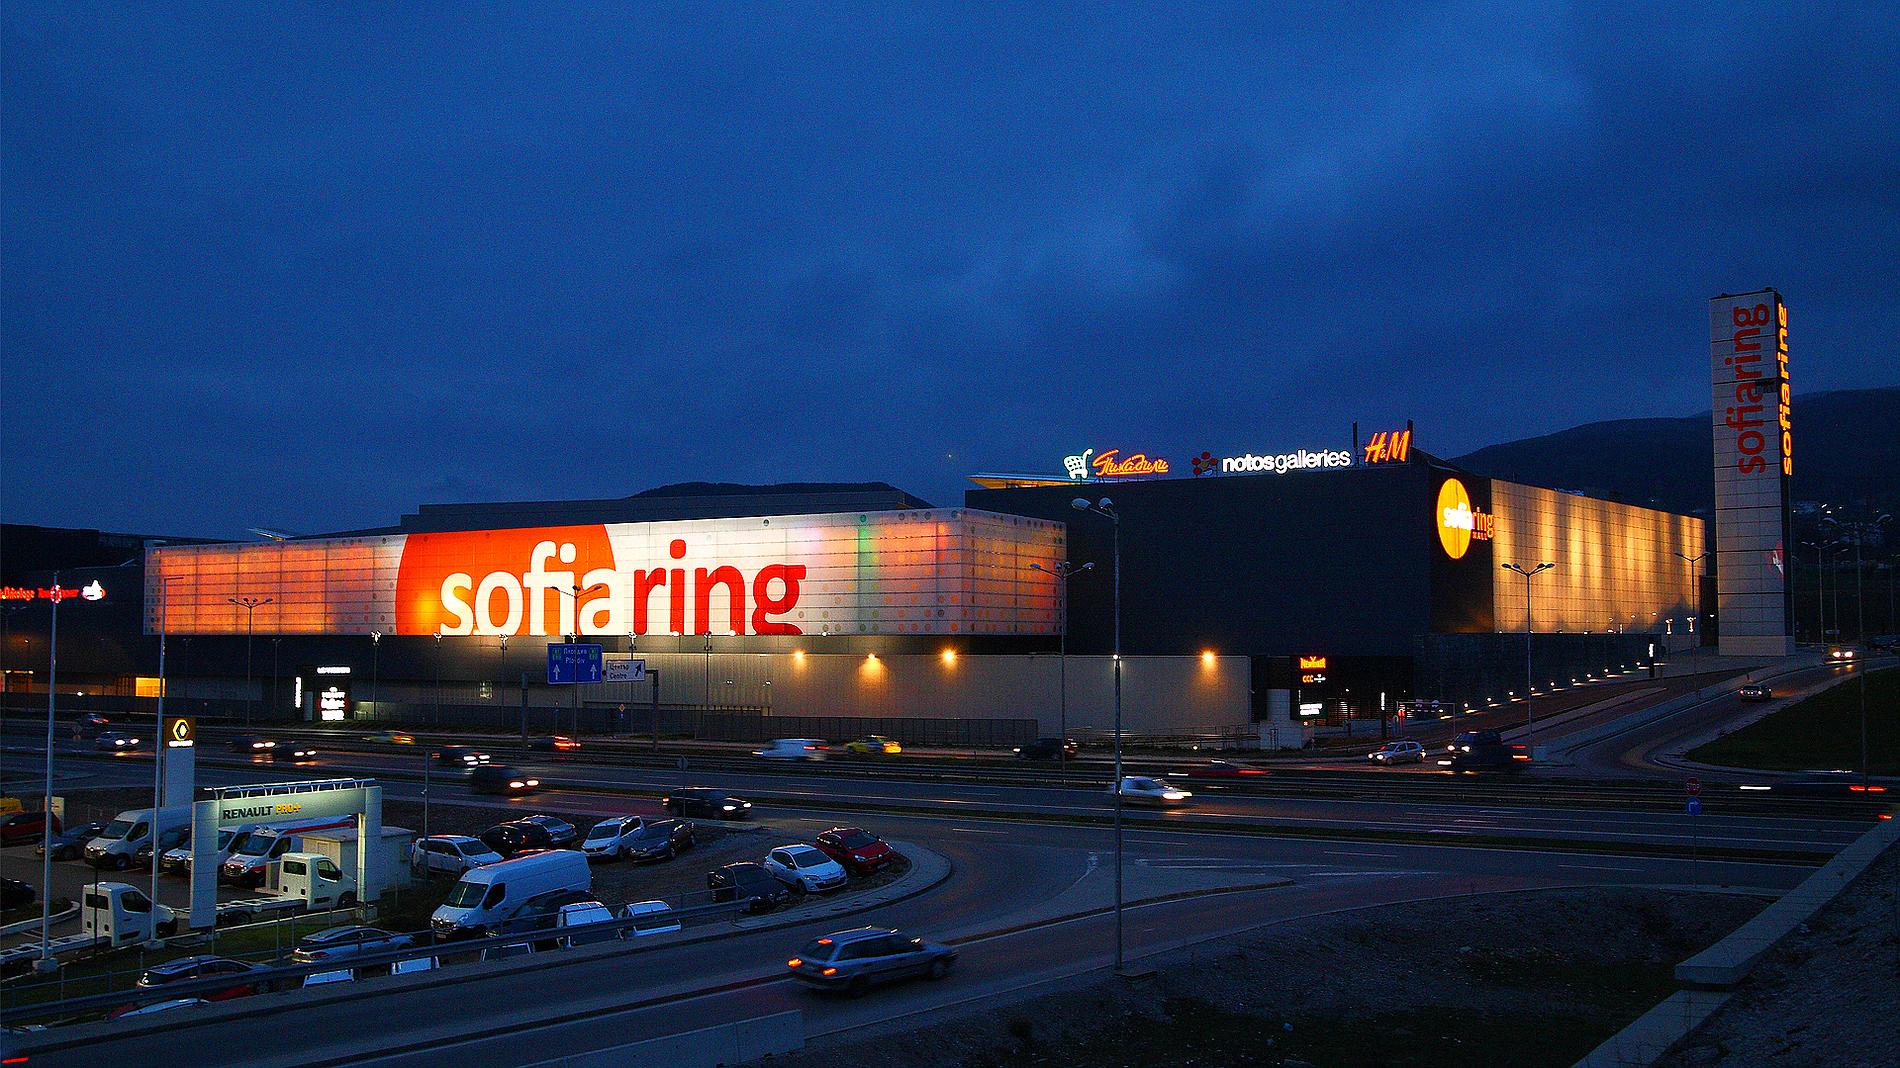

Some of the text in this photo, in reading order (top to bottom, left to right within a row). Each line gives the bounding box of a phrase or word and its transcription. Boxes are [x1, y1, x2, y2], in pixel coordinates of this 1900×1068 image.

[1725, 303, 1770, 474] sofiaring
[1778, 302, 1792, 476] sofiaring
[1364, 430, 1410, 463] H&M
[440, 539, 807, 636] sofiaring
[222, 803, 302, 820] RENAULT PRO+
